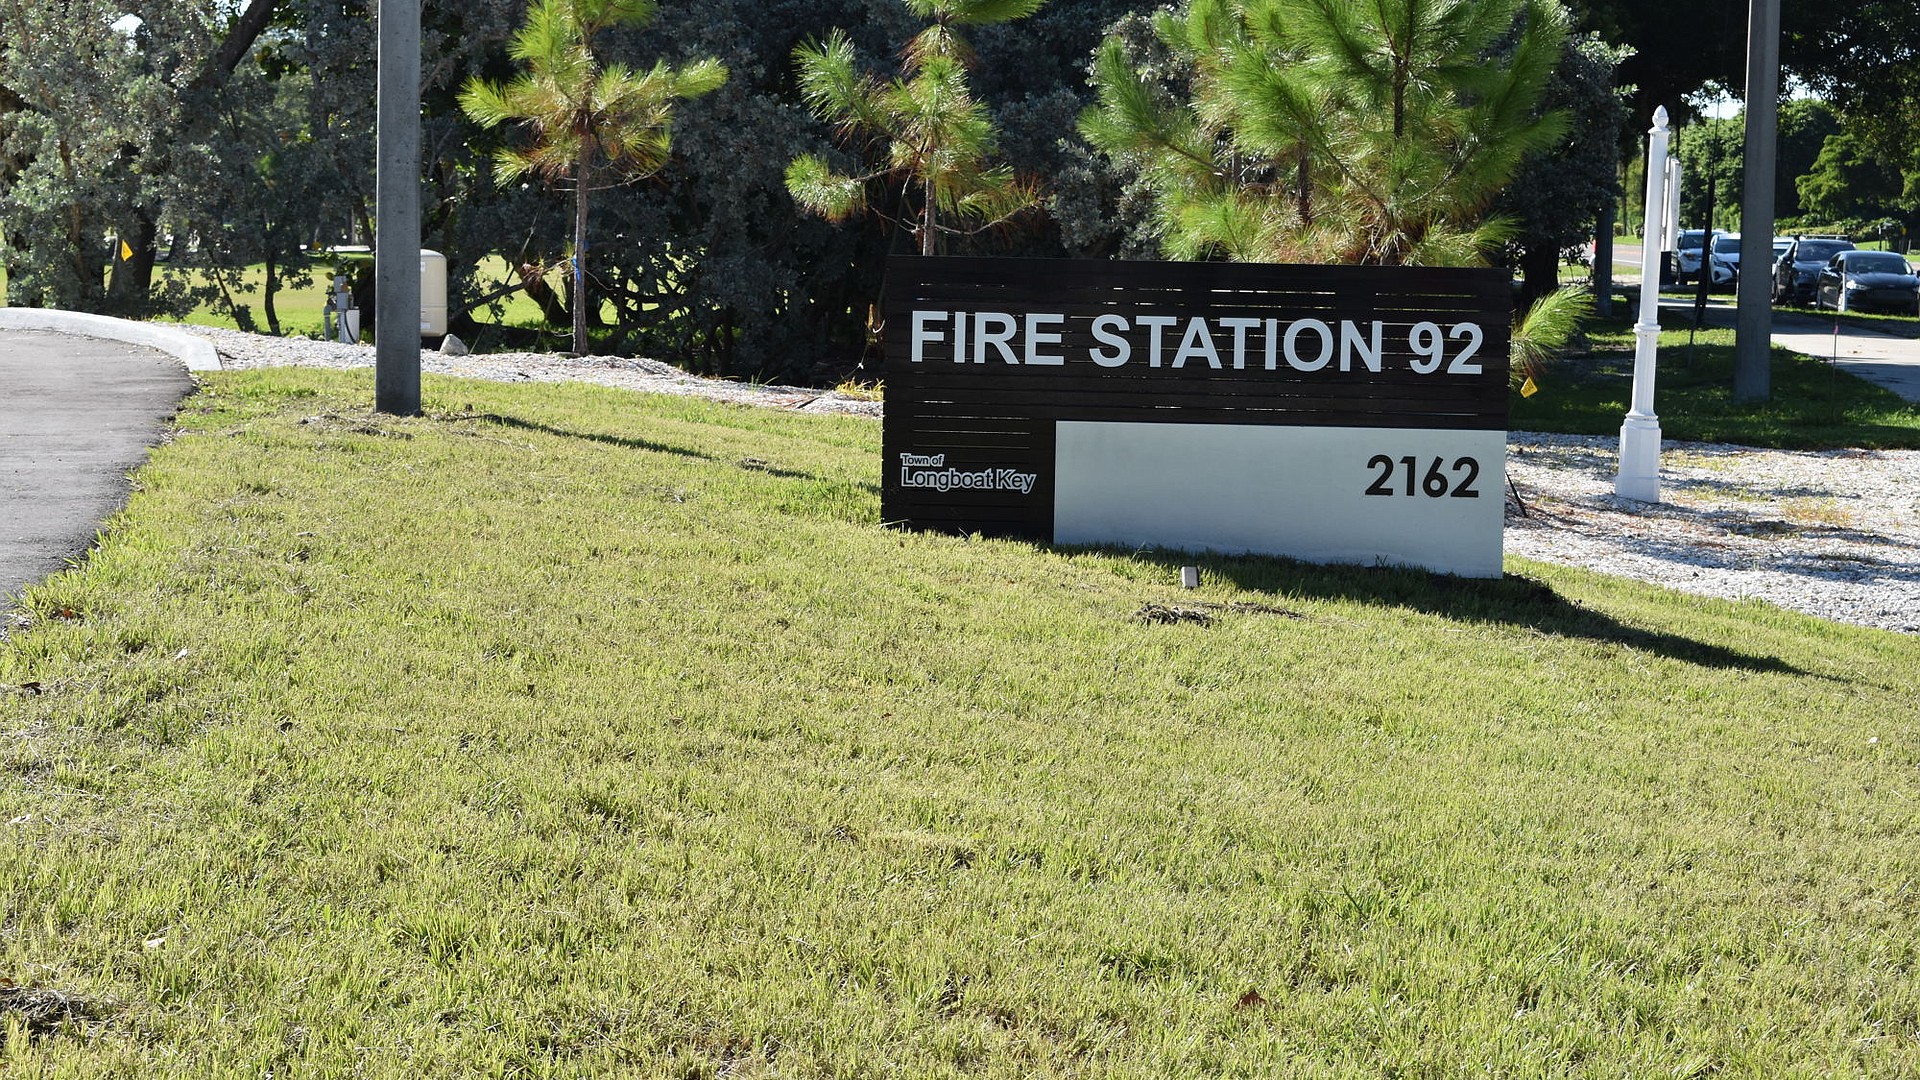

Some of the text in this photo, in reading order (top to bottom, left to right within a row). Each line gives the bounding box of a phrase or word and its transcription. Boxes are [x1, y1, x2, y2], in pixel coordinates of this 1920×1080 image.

[911, 310, 1484, 376] FIRE STATION 92
[900, 453, 945, 467] Town of
[1364, 453, 1480, 499] 2162
[901, 467, 1037, 494] Longboat Key
